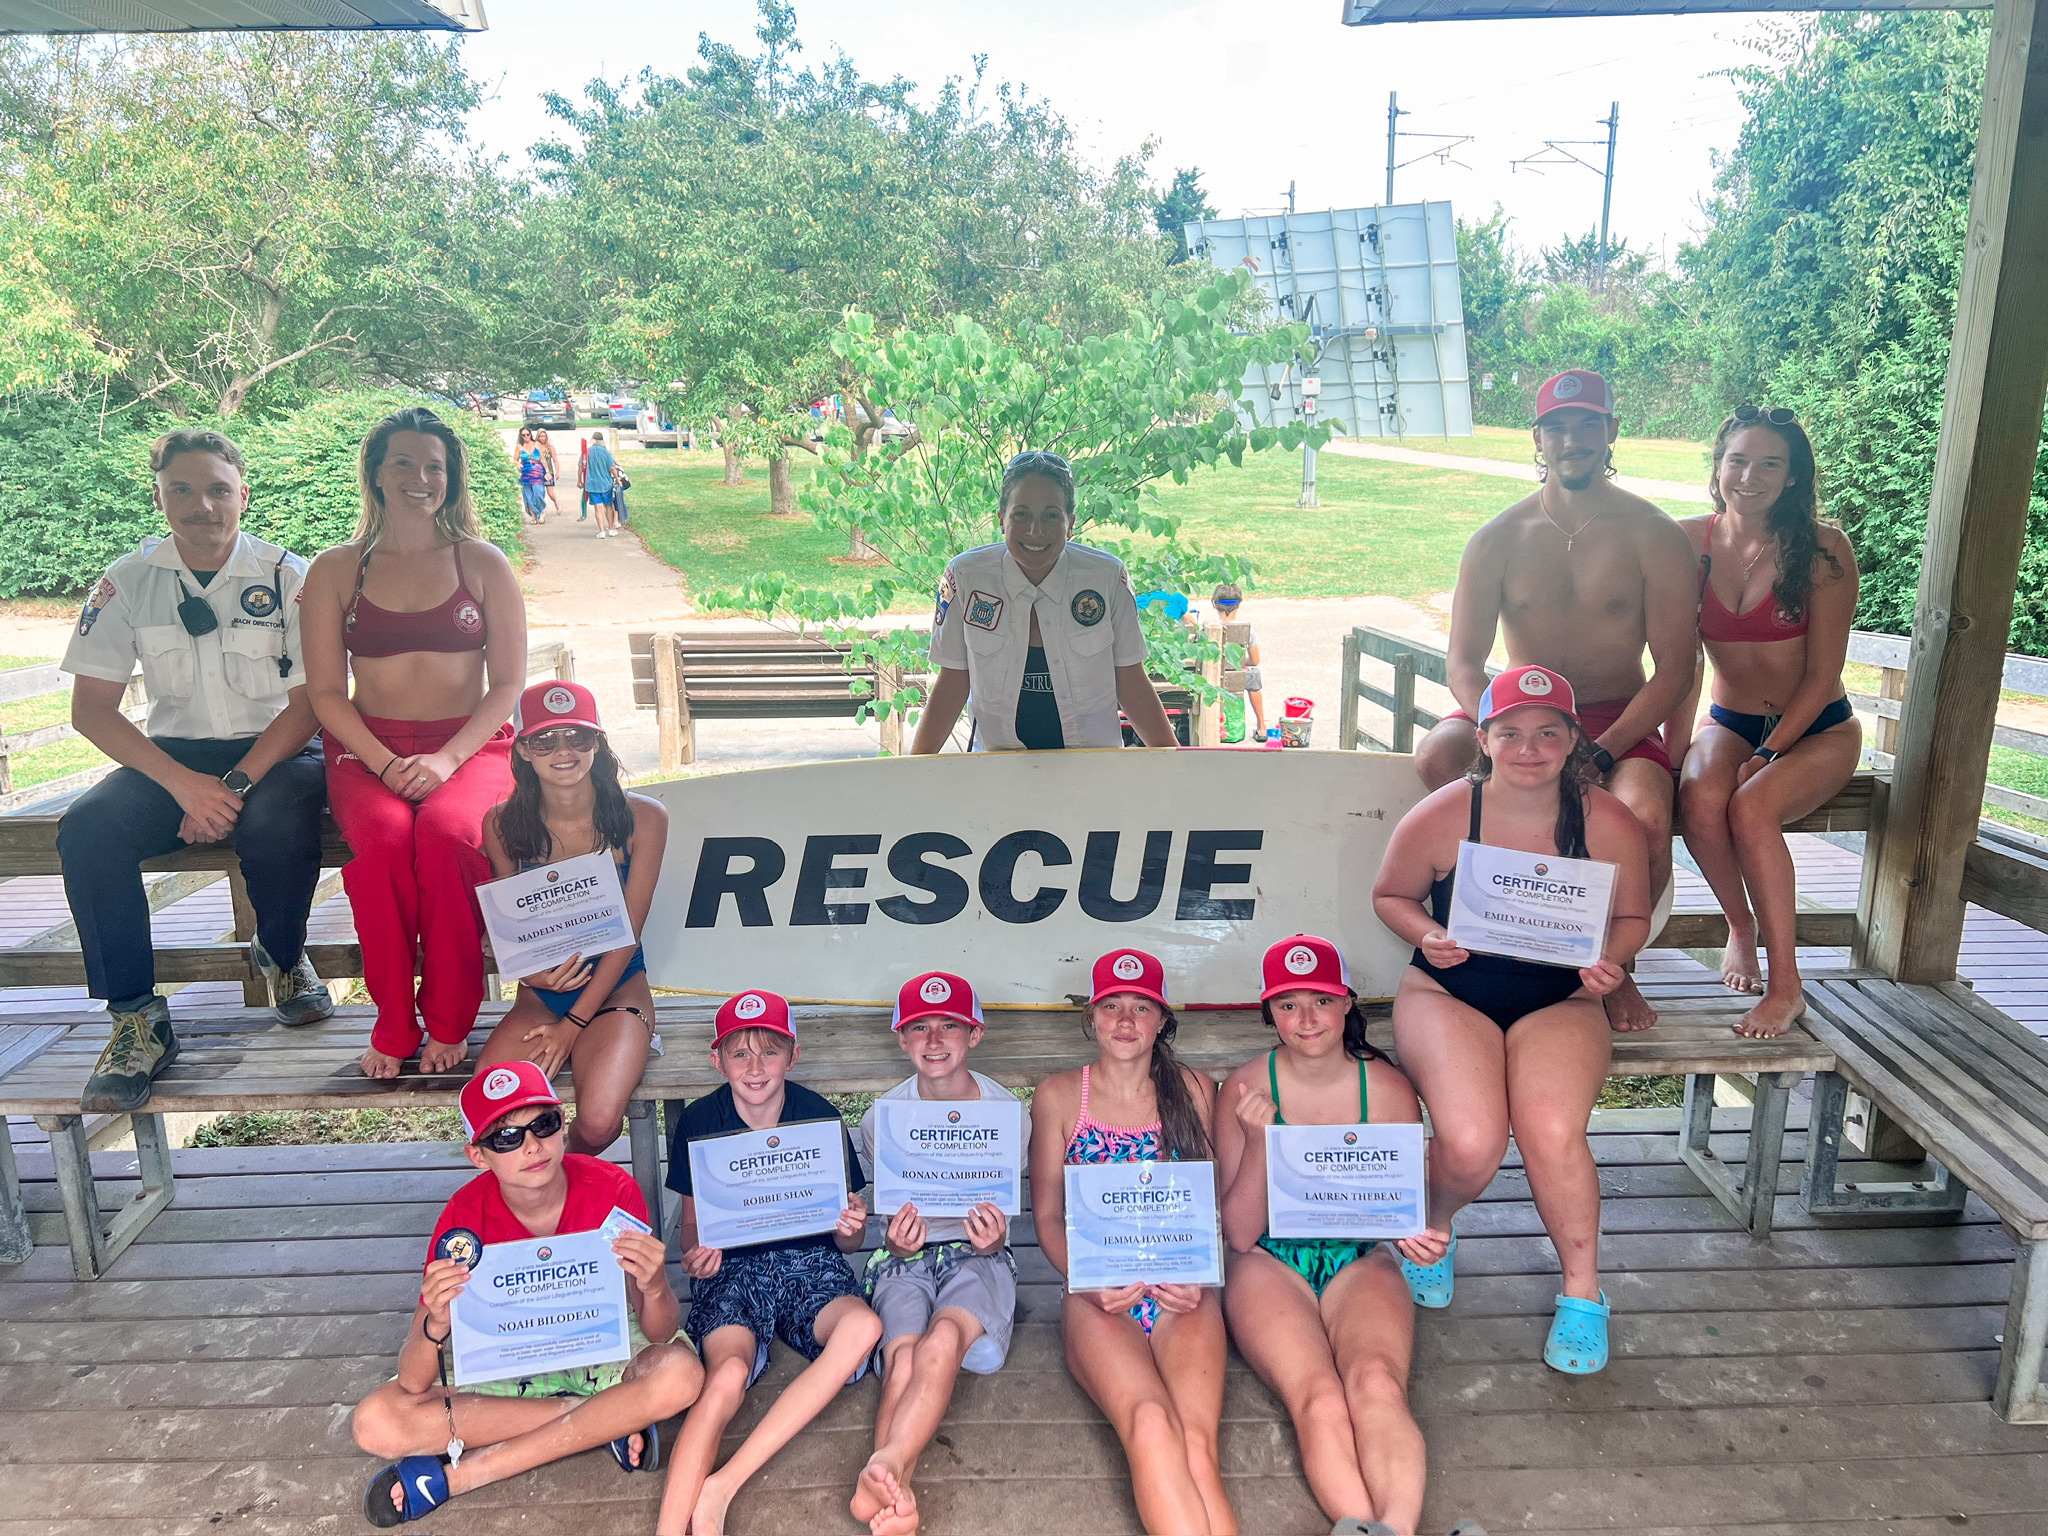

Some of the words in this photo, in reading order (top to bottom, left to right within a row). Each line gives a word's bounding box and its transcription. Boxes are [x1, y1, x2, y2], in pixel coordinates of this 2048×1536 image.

[685, 829, 1264, 928] RESCUE
[1492, 874, 1586, 897] CERTIFICATE
[516, 876, 598, 908] CERTIFICATE
[529, 903, 540, 913] OF
[541, 889, 590, 909] COMPLETION
[1502, 887, 1515, 895] OF
[1516, 889, 1573, 904] COMPLETION
[517, 923, 563, 943] MADELYN
[564, 908, 613, 929] BILODEAU
[1484, 911, 1517, 923] EMILY
[1518, 917, 1583, 933] RAULERSON
[909, 1128, 999, 1141] CERTIFICATE
[920, 1142, 932, 1150] OF
[933, 1142, 988, 1150] COMPLETION
[729, 1148, 821, 1172] CERTIFICATE
[1304, 1150, 1399, 1163] CERTIFICATE
[741, 1170, 753, 1178] OF
[755, 1161, 810, 1176] COMPLETION
[901, 1170, 939, 1179] RONAN
[940, 1170, 1004, 1180] CAMBRIDGE
[1316, 1164, 1328, 1172] OF
[1330, 1163, 1388, 1172] COMPLETION
[743, 1193, 783, 1207] ROBBIE
[784, 1188, 814, 1200] SHAW
[1101, 1189, 1192, 1204] CERTIFICATE
[1305, 1192, 1348, 1201] LAUREN
[1350, 1191, 1403, 1201] THEBEAU
[1113, 1205, 1125, 1213] OF
[1126, 1203, 1181, 1213] COMPLETION
[1104, 1235, 1140, 1246] JEMMA
[1142, 1233, 1193, 1244] HAYWARD
[493, 1261, 599, 1288] CERTIFICATE
[507, 1287, 520, 1297] OF
[523, 1277, 586, 1294] COMPLETION
[497, 1318, 534, 1333] NOAH
[537, 1308, 600, 1326] BILODEAU
